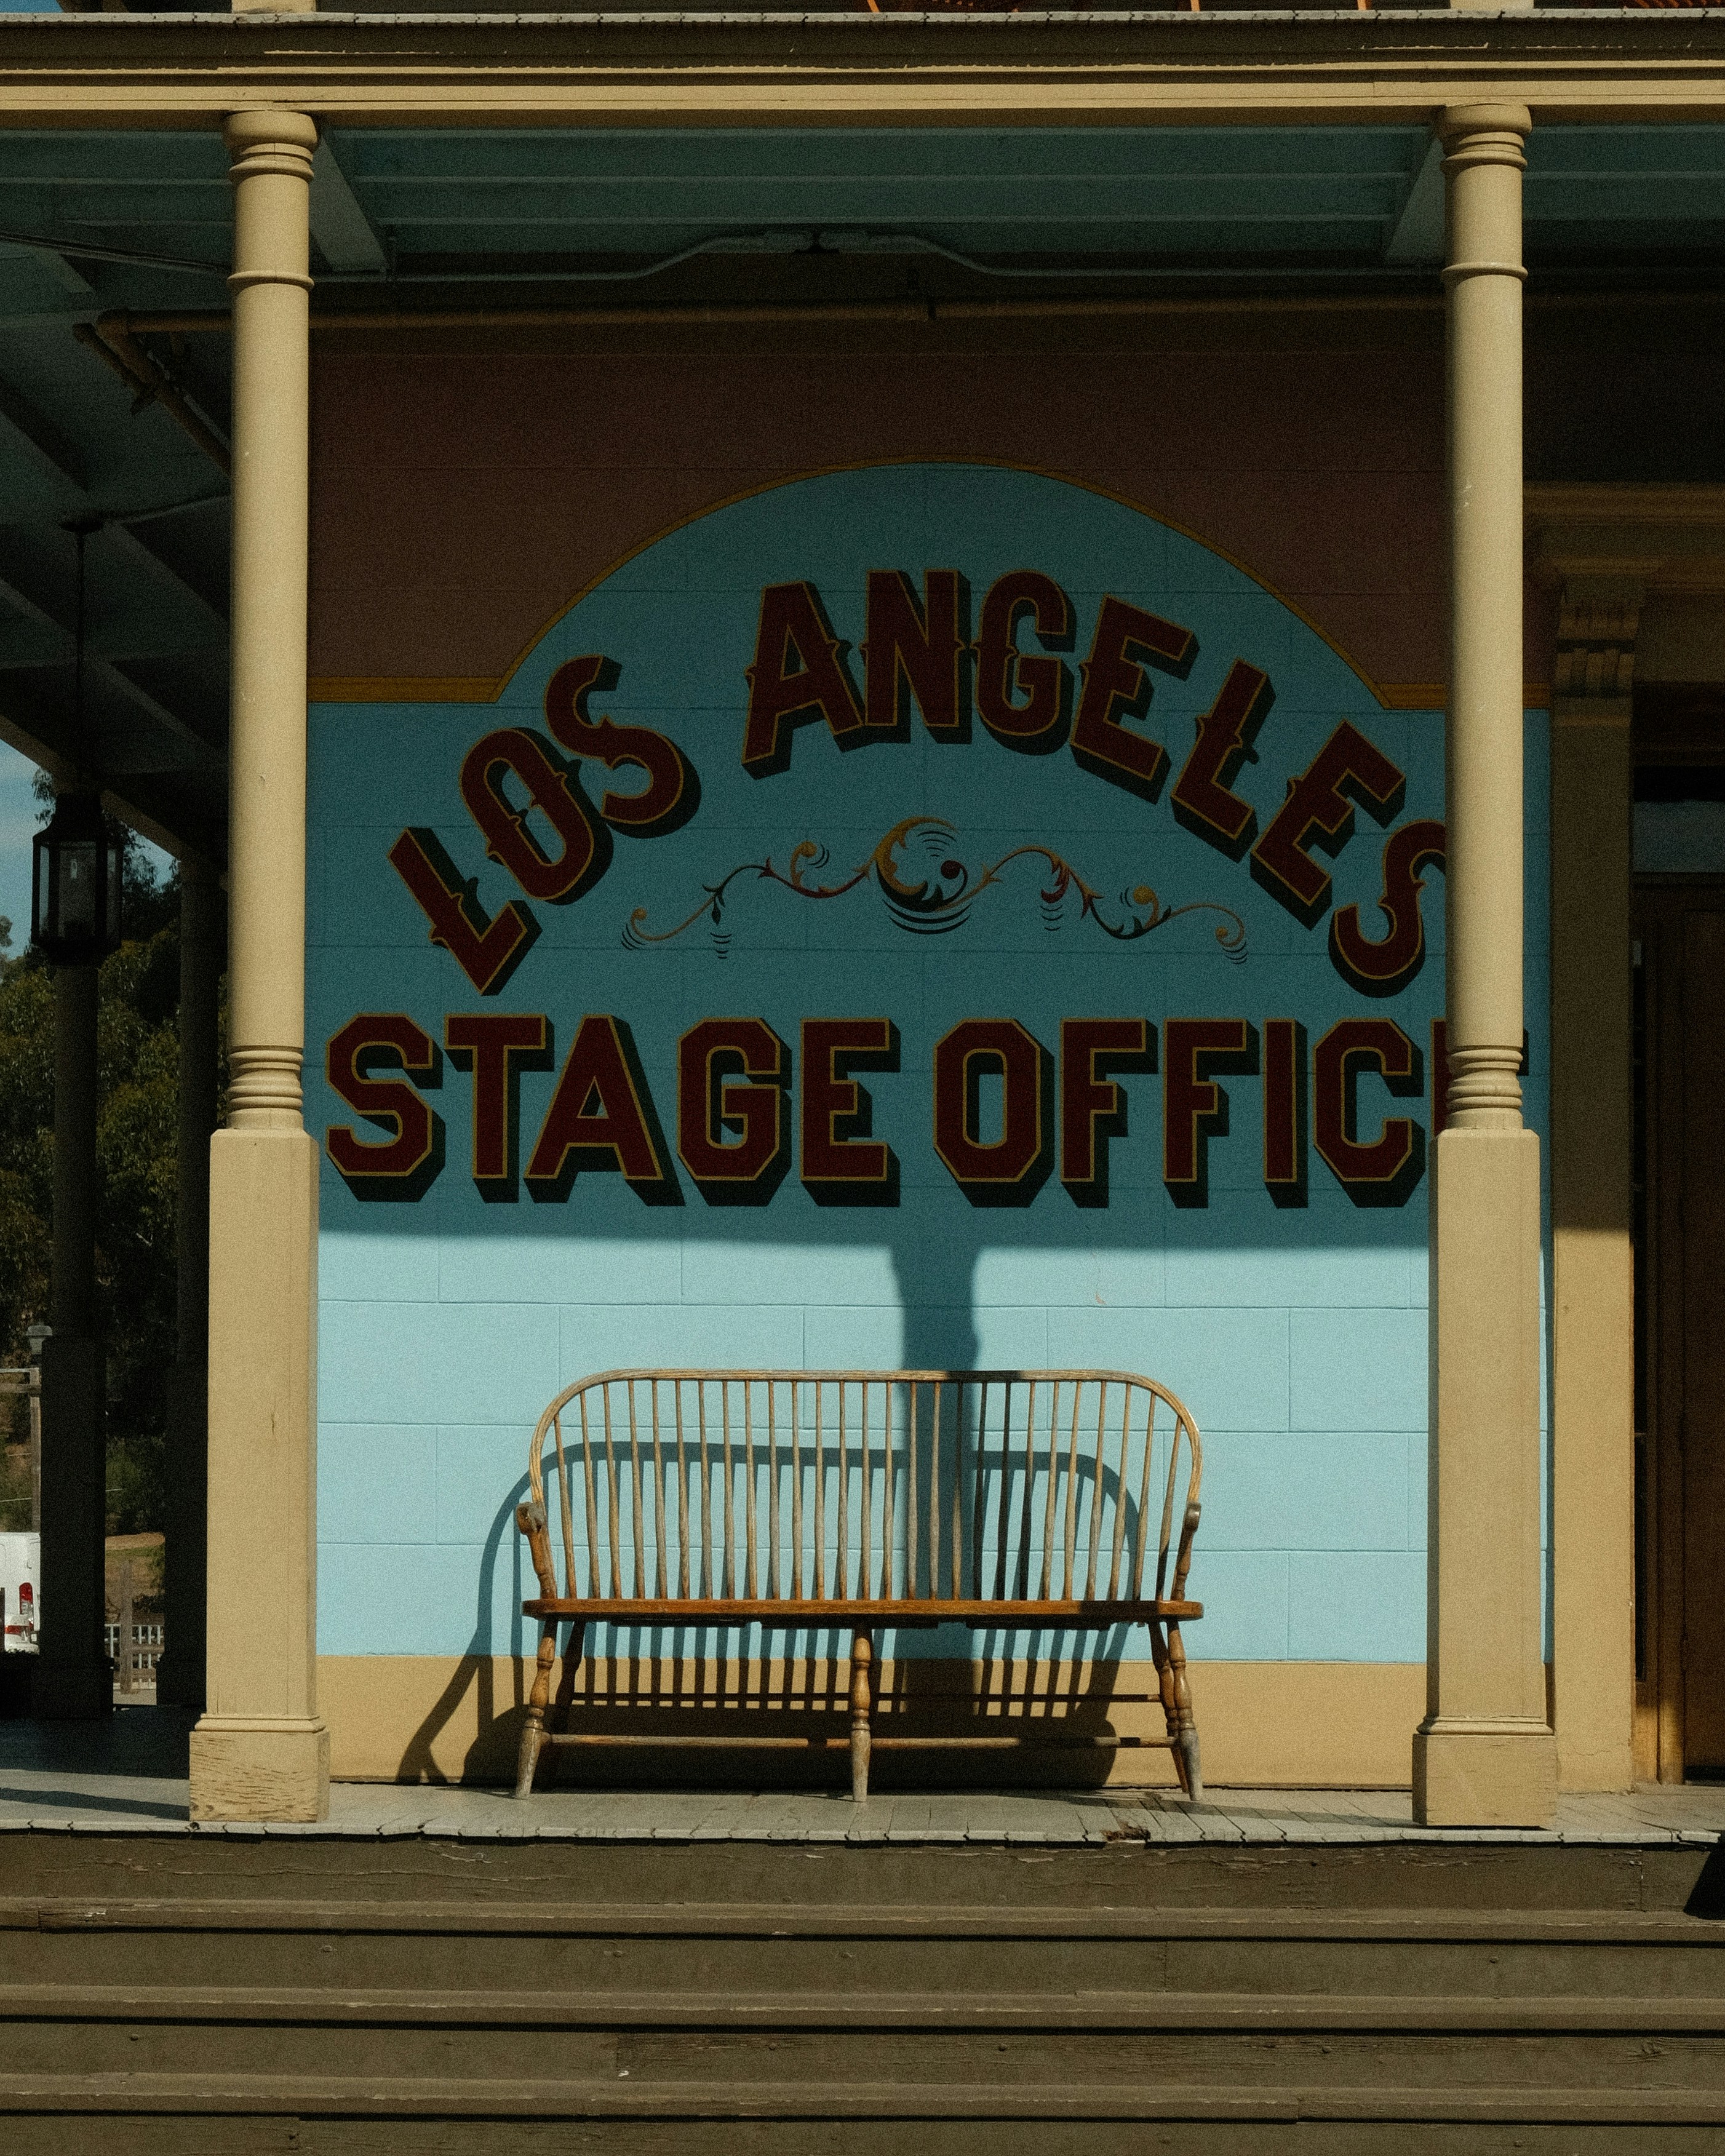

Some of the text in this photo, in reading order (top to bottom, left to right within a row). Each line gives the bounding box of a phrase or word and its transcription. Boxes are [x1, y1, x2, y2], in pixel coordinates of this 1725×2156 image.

[387, 569, 1446, 998] LOS ANGELES
[325, 1012, 1528, 1209] STAGE OFFIC
